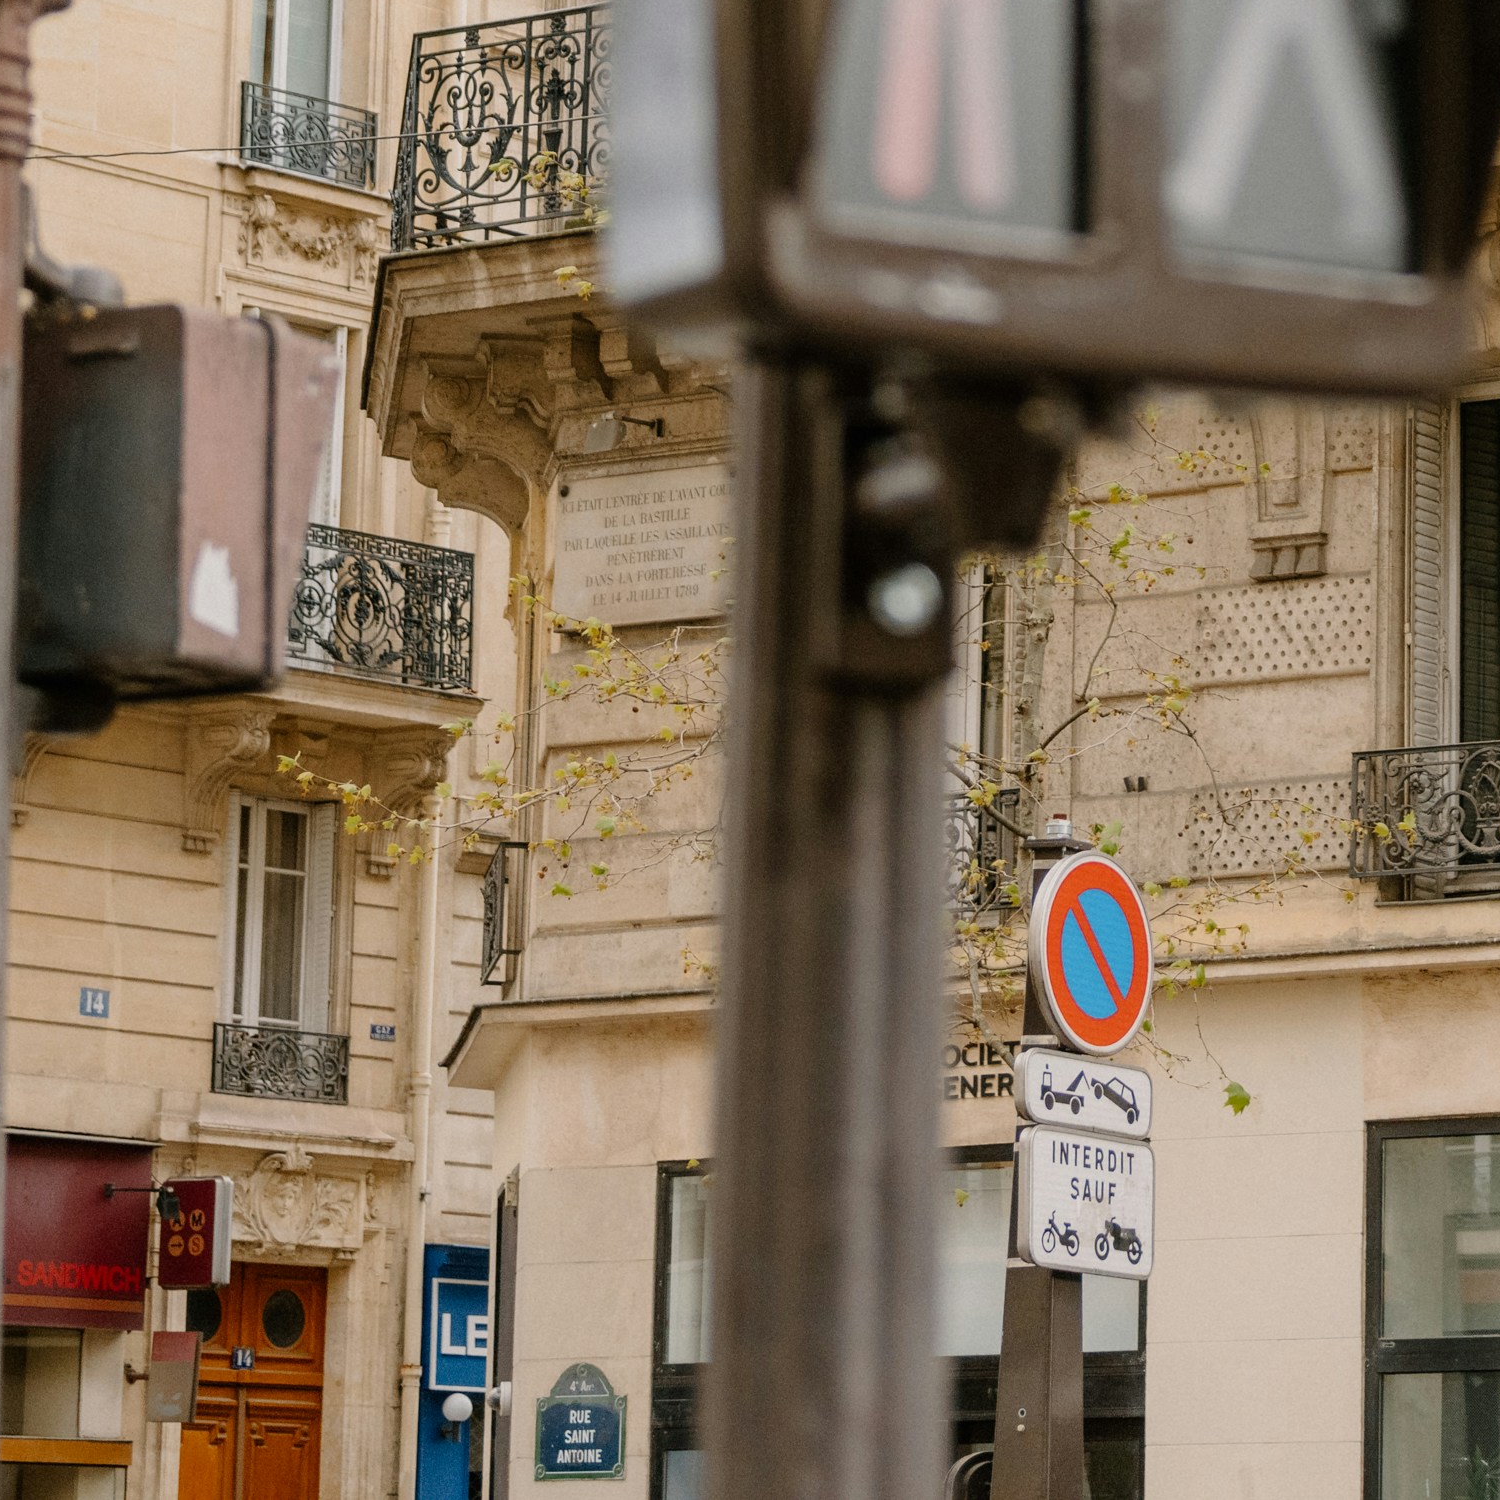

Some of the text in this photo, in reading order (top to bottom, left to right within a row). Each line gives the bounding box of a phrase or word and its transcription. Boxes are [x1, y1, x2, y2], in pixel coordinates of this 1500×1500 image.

[653, 490, 666, 503] DE
[670, 486, 707, 502] L'AVANT
[710, 483, 732, 497] COU
[604, 507, 690, 528] DE LA BASTILLE
[565, 539, 582, 551] PAR
[586, 533, 636, 550] LAQUELLE
[641, 530, 659, 543] LES
[586, 563, 707, 588] DANS LA FORTERESSE
[593, 584, 699, 606] LE 14 JUILLET 1789
[86, 991, 105, 1014] 14
[1052, 1140, 1135, 1175] INTERDIT
[1070, 1177, 1117, 1205] SAUF
[18, 1259, 141, 1292] SANDWICH
[236, 1351, 252, 1366] 14
[569, 1410, 591, 1424] RUE
[564, 1429, 596, 1444] SAINT
[556, 1449, 603, 1464] ANTOINE
